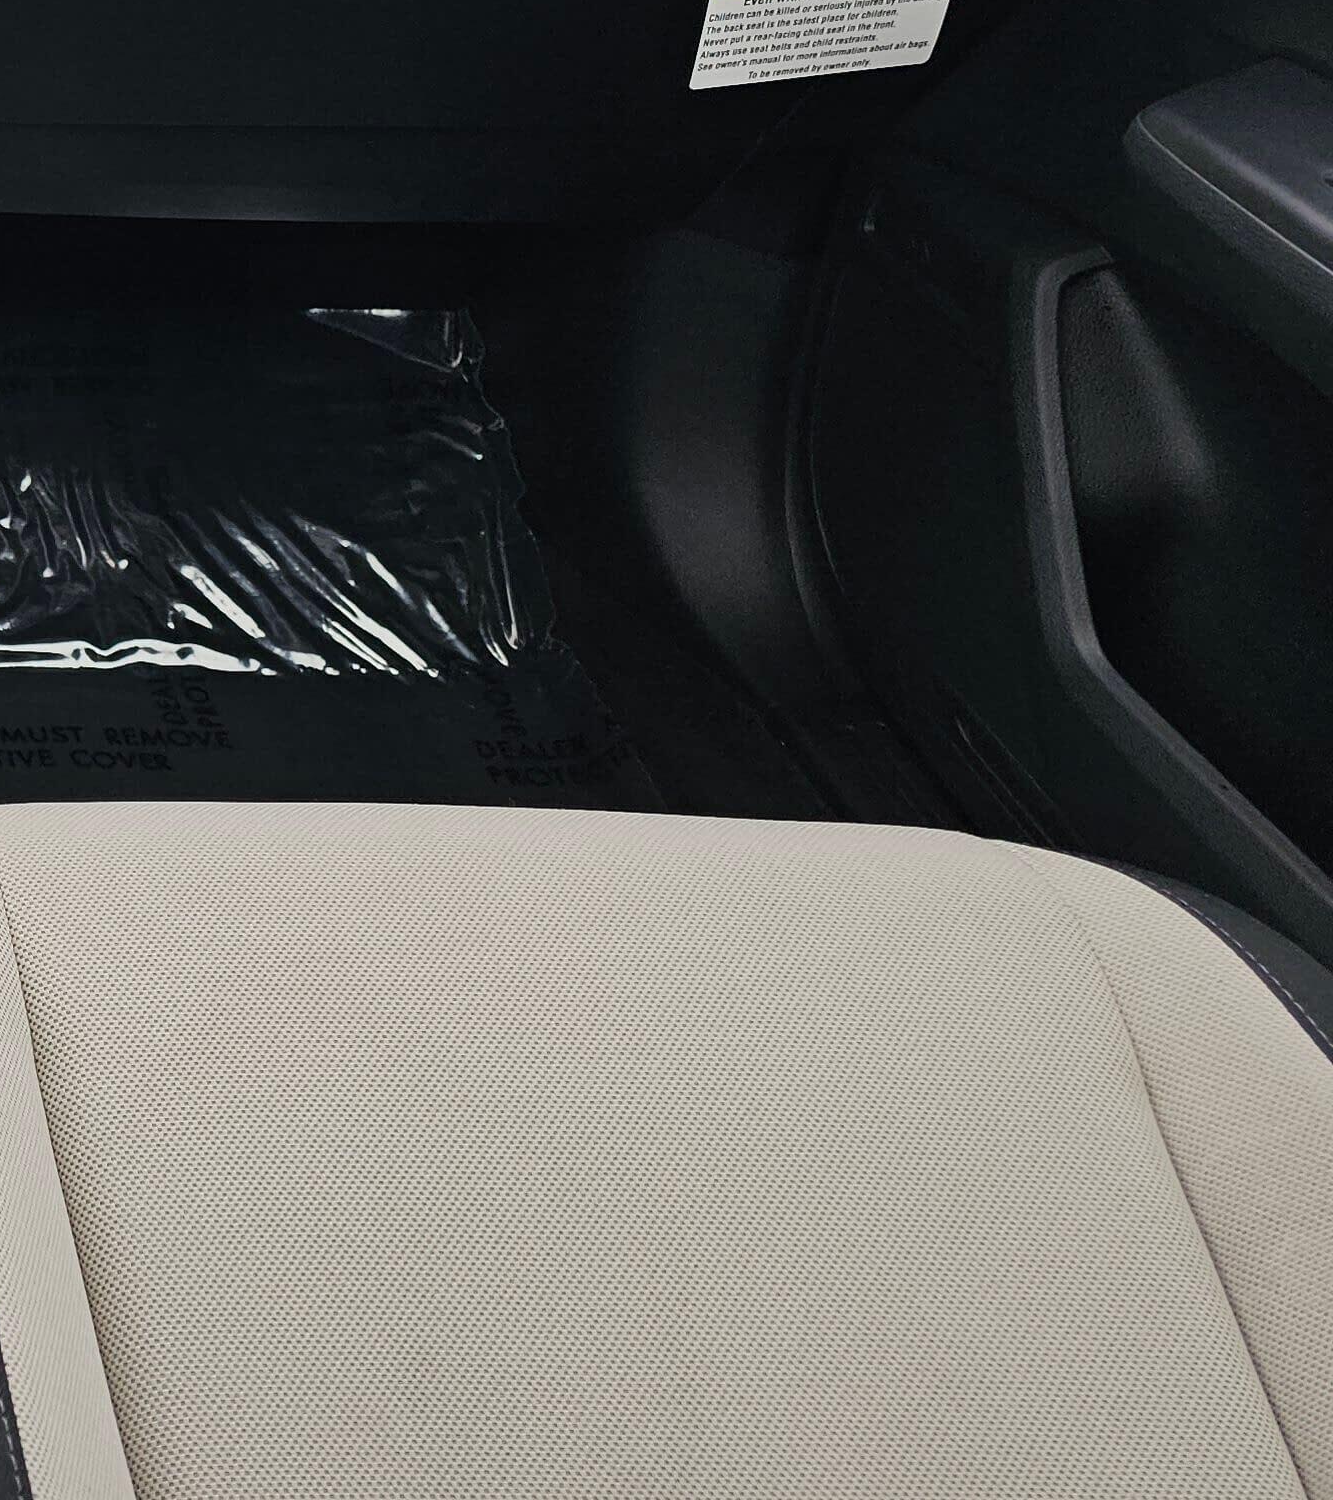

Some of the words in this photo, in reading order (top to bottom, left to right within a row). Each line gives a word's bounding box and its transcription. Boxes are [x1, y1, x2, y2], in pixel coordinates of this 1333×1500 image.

[706, 26, 722, 35] The
[724, 23, 744, 33] back
[746, 21, 765, 30] seat
[767, 20, 775, 29] is
[777, 18, 791, 28] the
[793, 16, 819, 26] safest
[821, 14, 845, 24] place
[847, 11, 859, 20] for
[861, 8, 899, 19] children.
[708, 12, 744, 22] Children
[764, 8, 774, 16] be
[776, 5, 801, 15] killed
[813, 1, 852, 12] seriously
[703, 38, 728, 47] Never
[729, 35, 745, 45] put
[753, 30, 801, 42] rear-facing
[803, 27, 825, 37] child
[827, 25, 845, 34] seat
[847, 23, 856, 32] in
[858, 21, 872, 31] the
[697, 63, 713, 72] See
[715, 58, 748, 69] owner's
[749, 54, 781, 66] manual
[782, 52, 794, 62] for
[796, 52, 818, 60] more
[820, 46, 868, 58] information
[869, 42, 893, 53] about
[894, 41, 907, 50] air
[700, 48, 730, 59] Always
[732, 48, 748, 56] use
[750, 44, 769, 54] seat
[770, 41, 791, 51] belts
[794, 39, 810, 49] and
[812, 37, 834, 47] child
[748, 70, 758, 80] To
[760, 69, 770, 78] be
[772, 64, 812, 76] removed
[812, 64, 822, 73] by
[823, 61, 850, 70] owner
[0, 724, 85, 747] MUST
[104, 725, 233, 750] REMOVE
[69, 749, 174, 772] COVER
